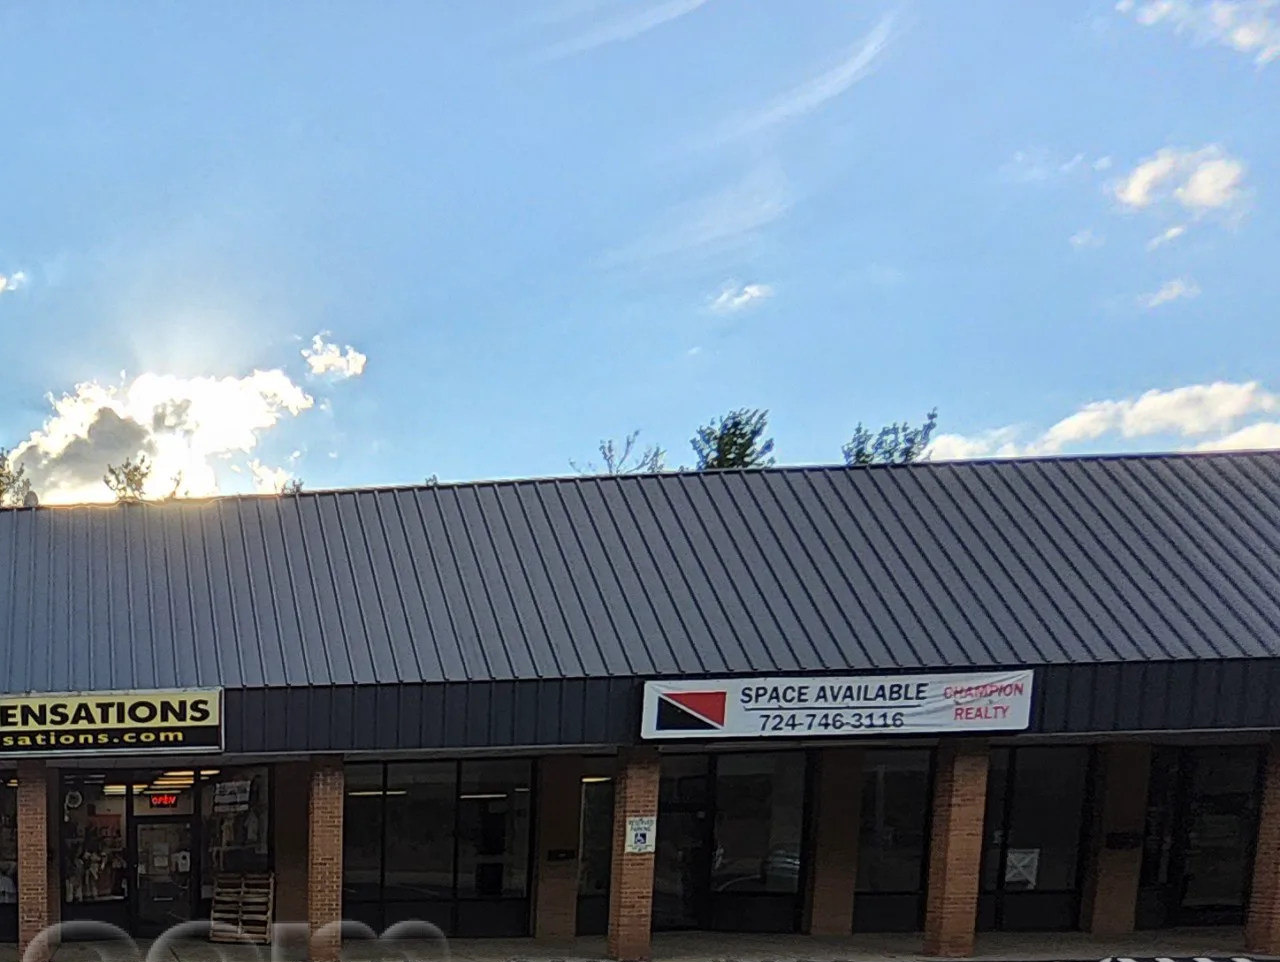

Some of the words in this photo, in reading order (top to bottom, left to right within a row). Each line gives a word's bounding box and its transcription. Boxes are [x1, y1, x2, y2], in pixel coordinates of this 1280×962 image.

[740, 684, 809, 705] SPACE
[814, 682, 930, 704] AVAILABLE
[943, 683, 1025, 700] CHAMPION
[758, 711, 905, 731] 724-746-3116
[953, 705, 1010, 721] REALTY
